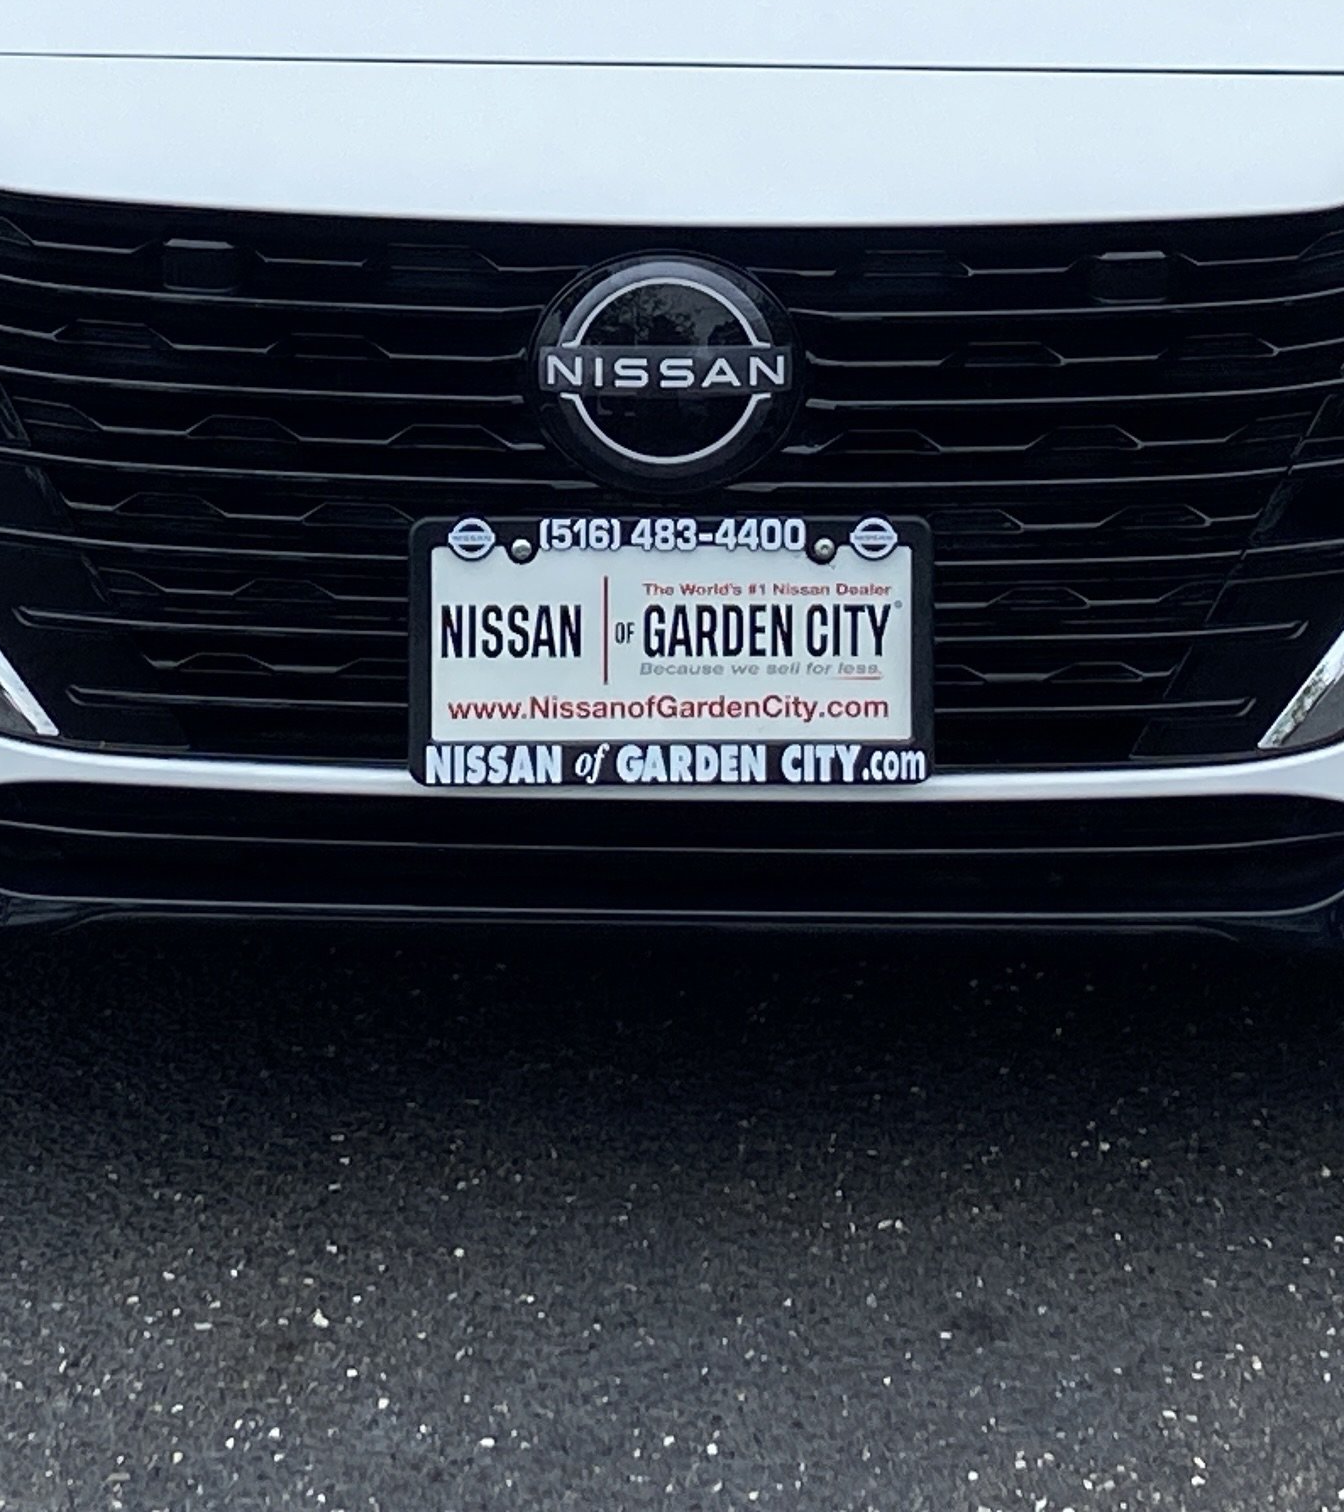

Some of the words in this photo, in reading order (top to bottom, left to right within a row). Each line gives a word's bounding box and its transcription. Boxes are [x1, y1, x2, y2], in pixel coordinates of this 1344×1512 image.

[547, 355, 785, 388] NISSAN
[539, 518, 622, 551] (516)
[631, 518, 806, 552] 483-4400
[642, 582, 675, 596] The
[680, 582, 742, 596] World's
[748, 582, 766, 596] #1
[773, 582, 830, 596] Nissan
[836, 582, 891, 596] Dealer
[441, 604, 581, 658] NISSAN
[615, 621, 635, 644] OF
[643, 603, 793, 658] GARDEN
[806, 603, 891, 658] CITY
[640, 662, 724, 676] Because
[731, 663, 760, 676] we
[766, 661, 801, 676] sell
[806, 661, 833, 676] for
[448, 694, 890, 723] www.NissanofGardenCity.com
[425, 744, 563, 784] NISSAN
[574, 743, 610, 784] of
[616, 744, 768, 784] GARDEN
